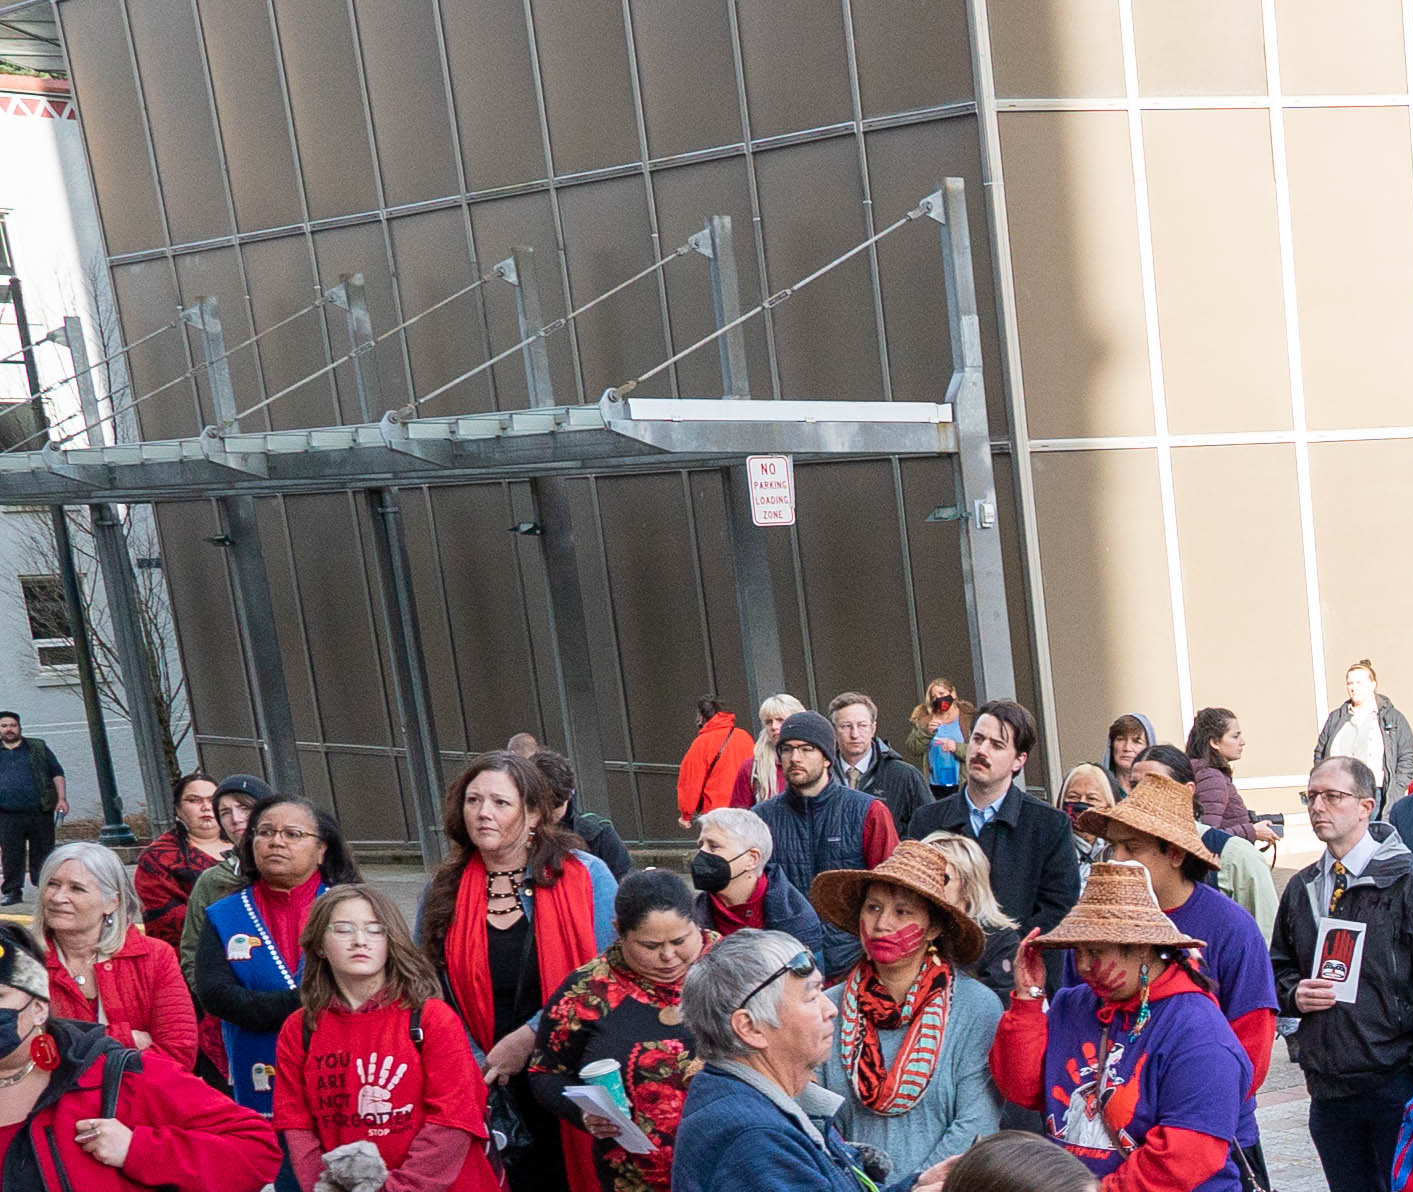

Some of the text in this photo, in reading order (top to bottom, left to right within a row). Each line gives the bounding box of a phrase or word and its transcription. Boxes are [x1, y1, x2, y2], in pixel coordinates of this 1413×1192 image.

[760, 463, 776, 475] NO
[753, 481, 788, 490] PARKING
[755, 496, 789, 505] LOADING
[763, 510, 783, 519] ZONE
[313, 1051, 350, 1069] YOU
[317, 1073, 346, 1090] ARE
[319, 1093, 351, 1109] NOT
[368, 1128, 390, 1137] STOP
